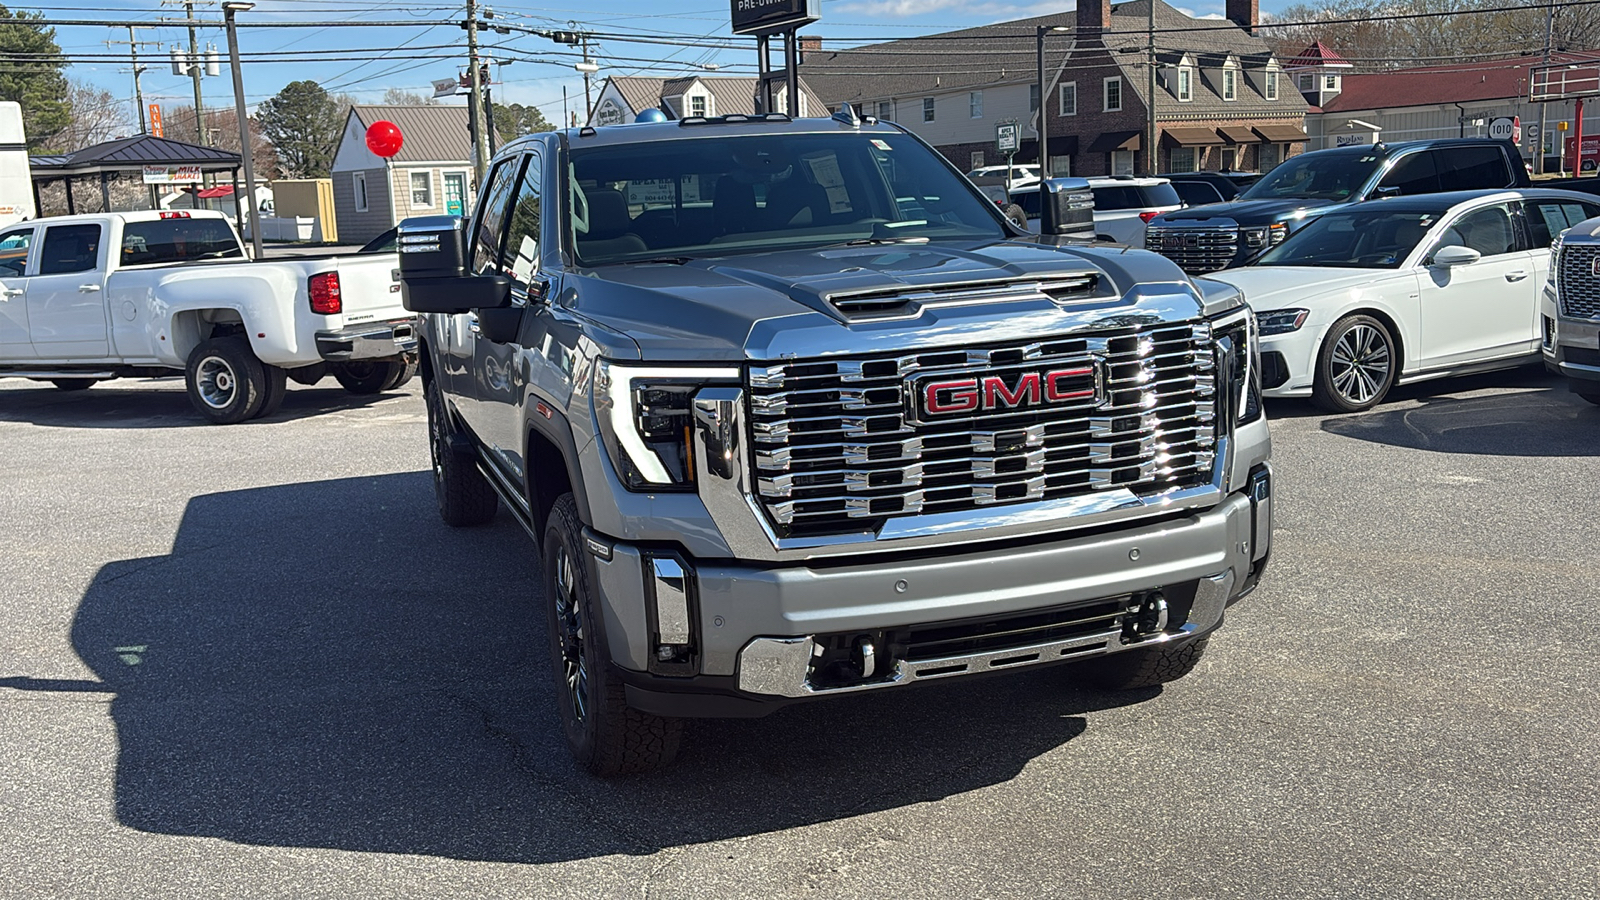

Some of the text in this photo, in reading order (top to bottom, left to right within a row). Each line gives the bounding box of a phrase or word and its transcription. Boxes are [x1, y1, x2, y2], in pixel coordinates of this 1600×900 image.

[738, 0, 786, 11] PRE-OW
[1493, 124, 1512, 135] 1010
[1163, 236, 1197, 248] GMC
[924, 366, 1096, 416] GMC
